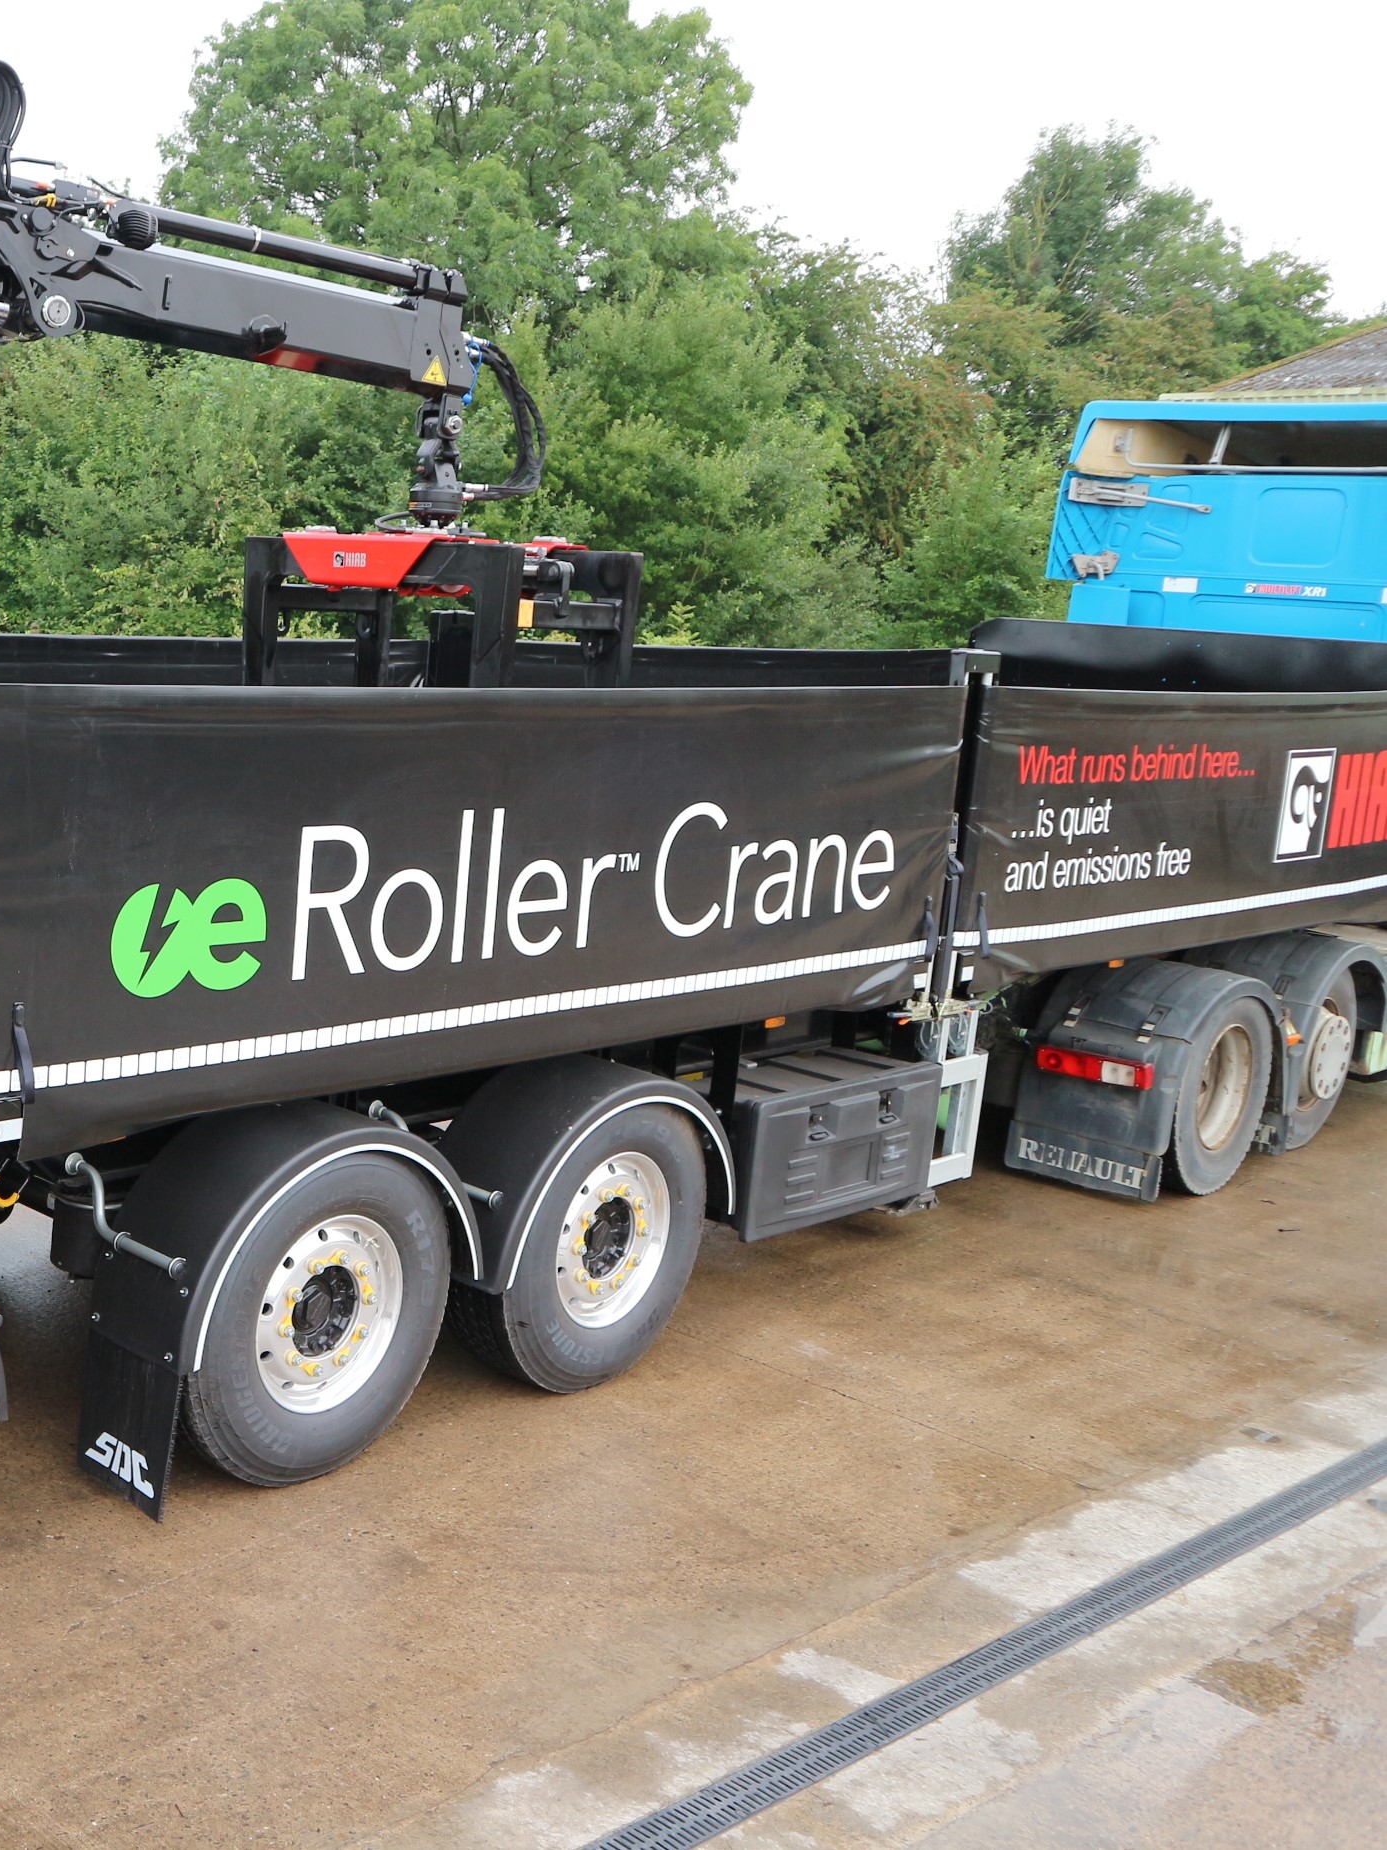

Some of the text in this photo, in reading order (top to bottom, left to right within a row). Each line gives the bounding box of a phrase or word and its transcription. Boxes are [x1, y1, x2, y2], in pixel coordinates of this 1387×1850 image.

[345, 552, 367, 567] HIAB
[1018, 744, 1256, 785] What runs behind here...
[1060, 797, 1113, 844] quiet
[1327, 750, 1387, 849] HIA
[654, 801, 896, 938] Crane
[1004, 841, 1192, 892] and emissions free
[84, 1431, 155, 1499] SDC
